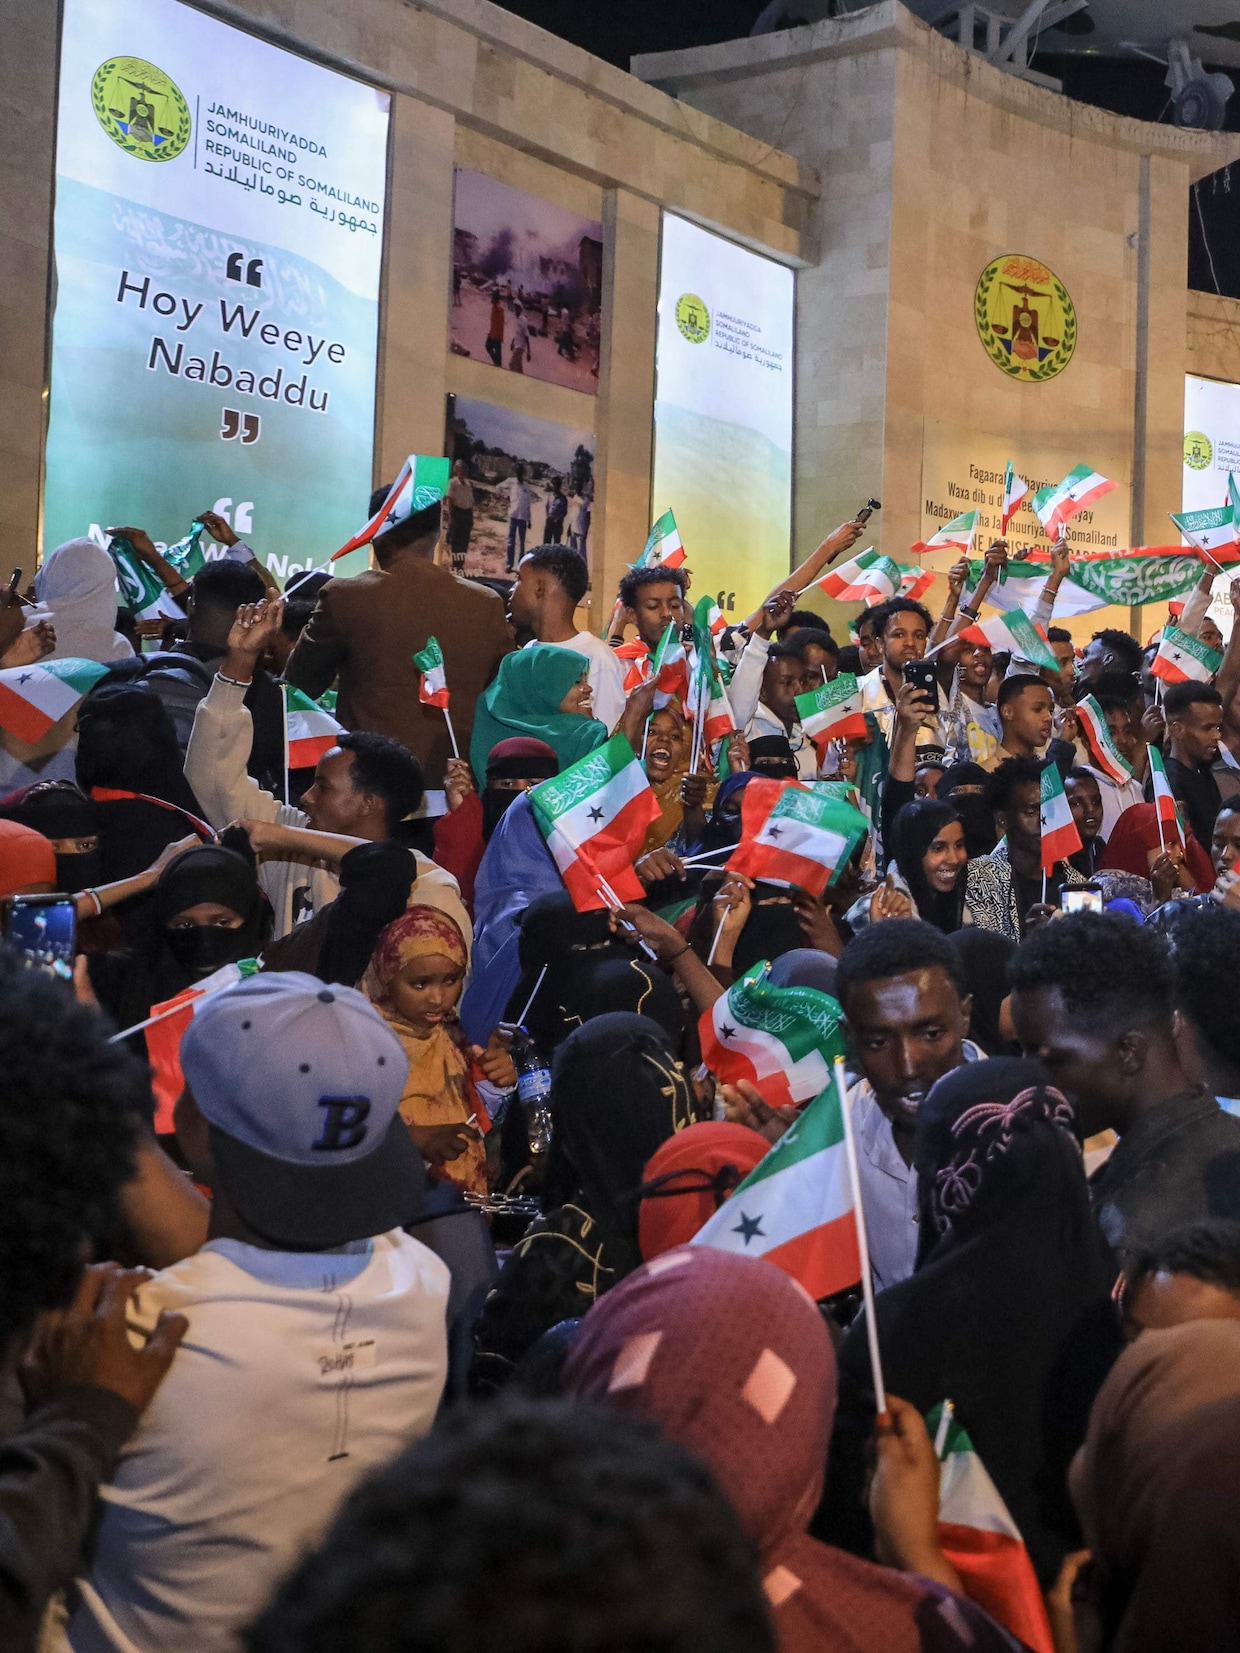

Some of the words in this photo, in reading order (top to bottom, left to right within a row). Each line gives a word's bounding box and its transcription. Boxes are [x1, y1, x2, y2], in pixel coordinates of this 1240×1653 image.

[206, 120, 297, 164] SOMALILAND
[207, 102, 327, 158] JAMHUURIYADDA
[205, 139, 272, 175] REPUBLIC
[276, 166, 295, 182] OF
[297, 174, 380, 215] SOMALILAND
[309, 198, 378, 237] جمهورية
[117, 270, 203, 331] Hoy
[219, 299, 346, 366] Weeye
[148, 337, 329, 412] Nabaddu
[948, 482, 970, 500] Waxa
[972, 488, 985, 504] dib
[1065, 526, 1118, 546] Somaliland
[311, 1093, 371, 1151] B
